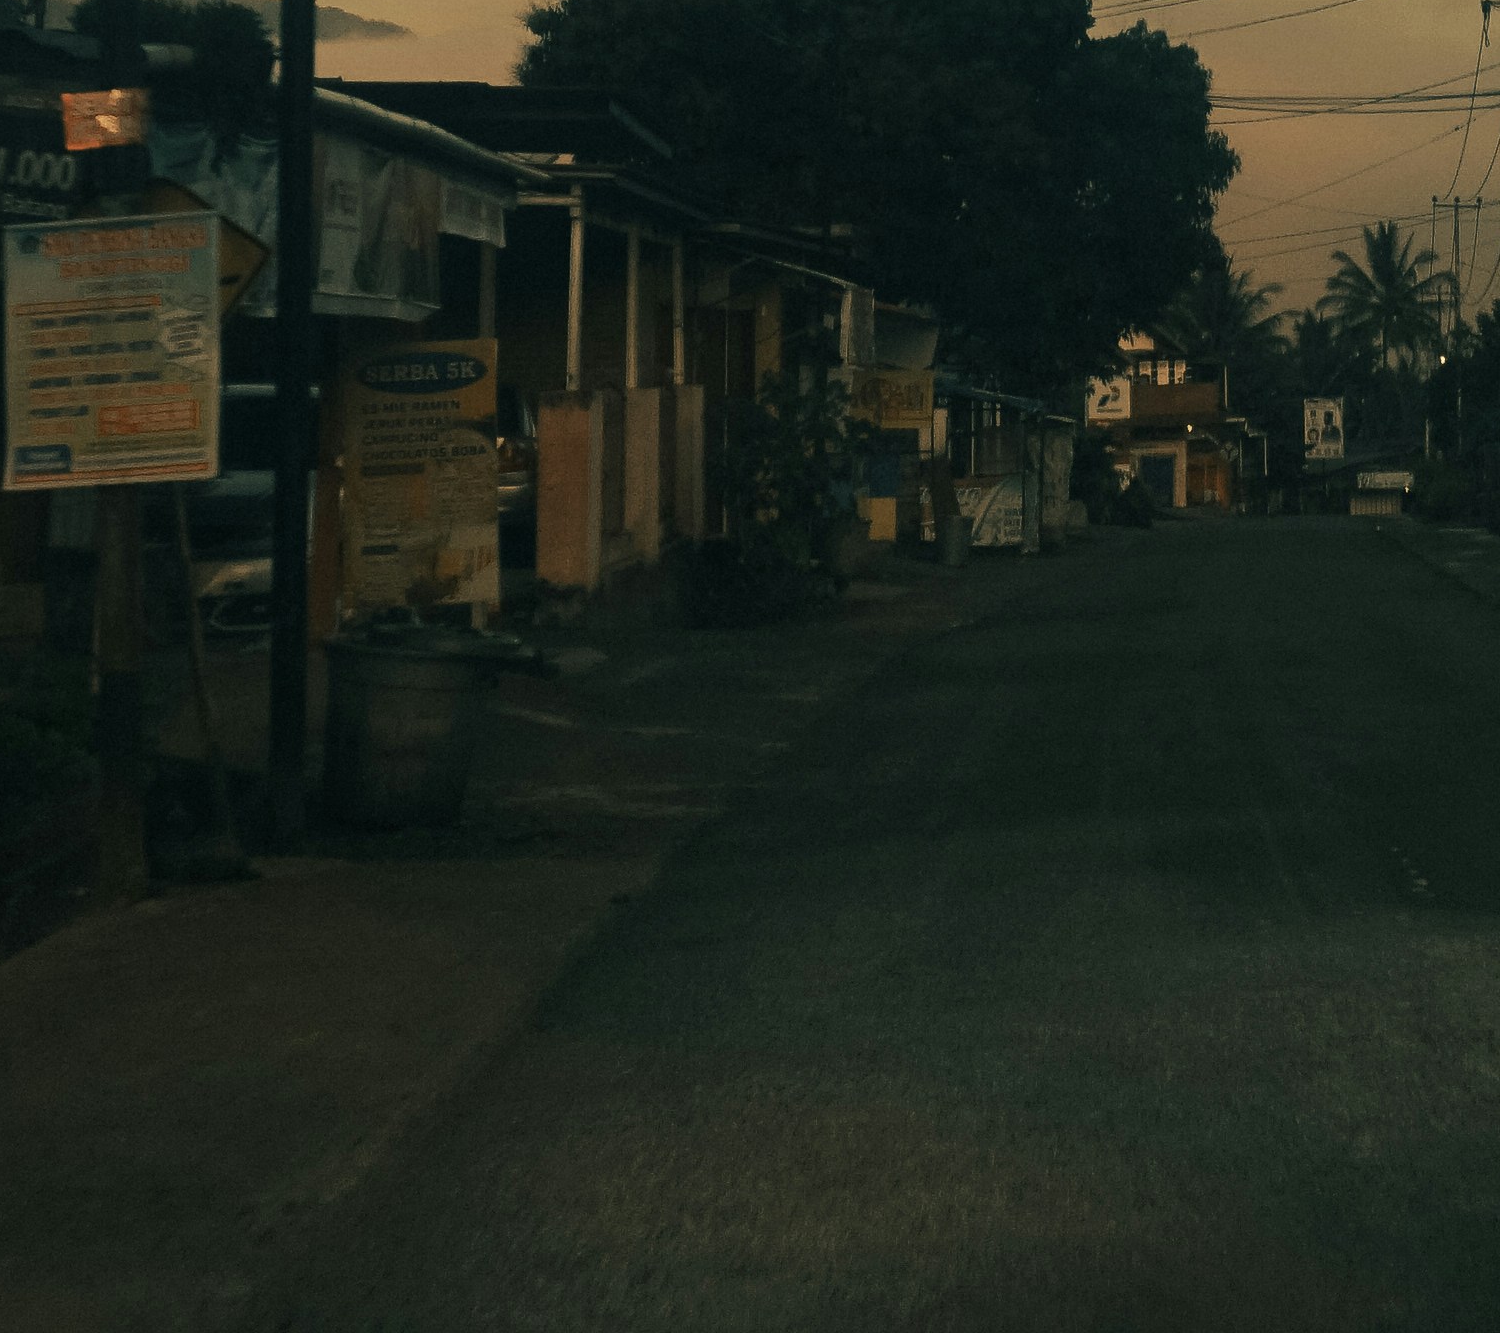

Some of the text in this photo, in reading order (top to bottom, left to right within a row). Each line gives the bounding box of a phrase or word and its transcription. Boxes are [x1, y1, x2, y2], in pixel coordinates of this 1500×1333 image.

[366, 361, 477, 383] SERBA 5K
[451, 445, 487, 456] BOBA
